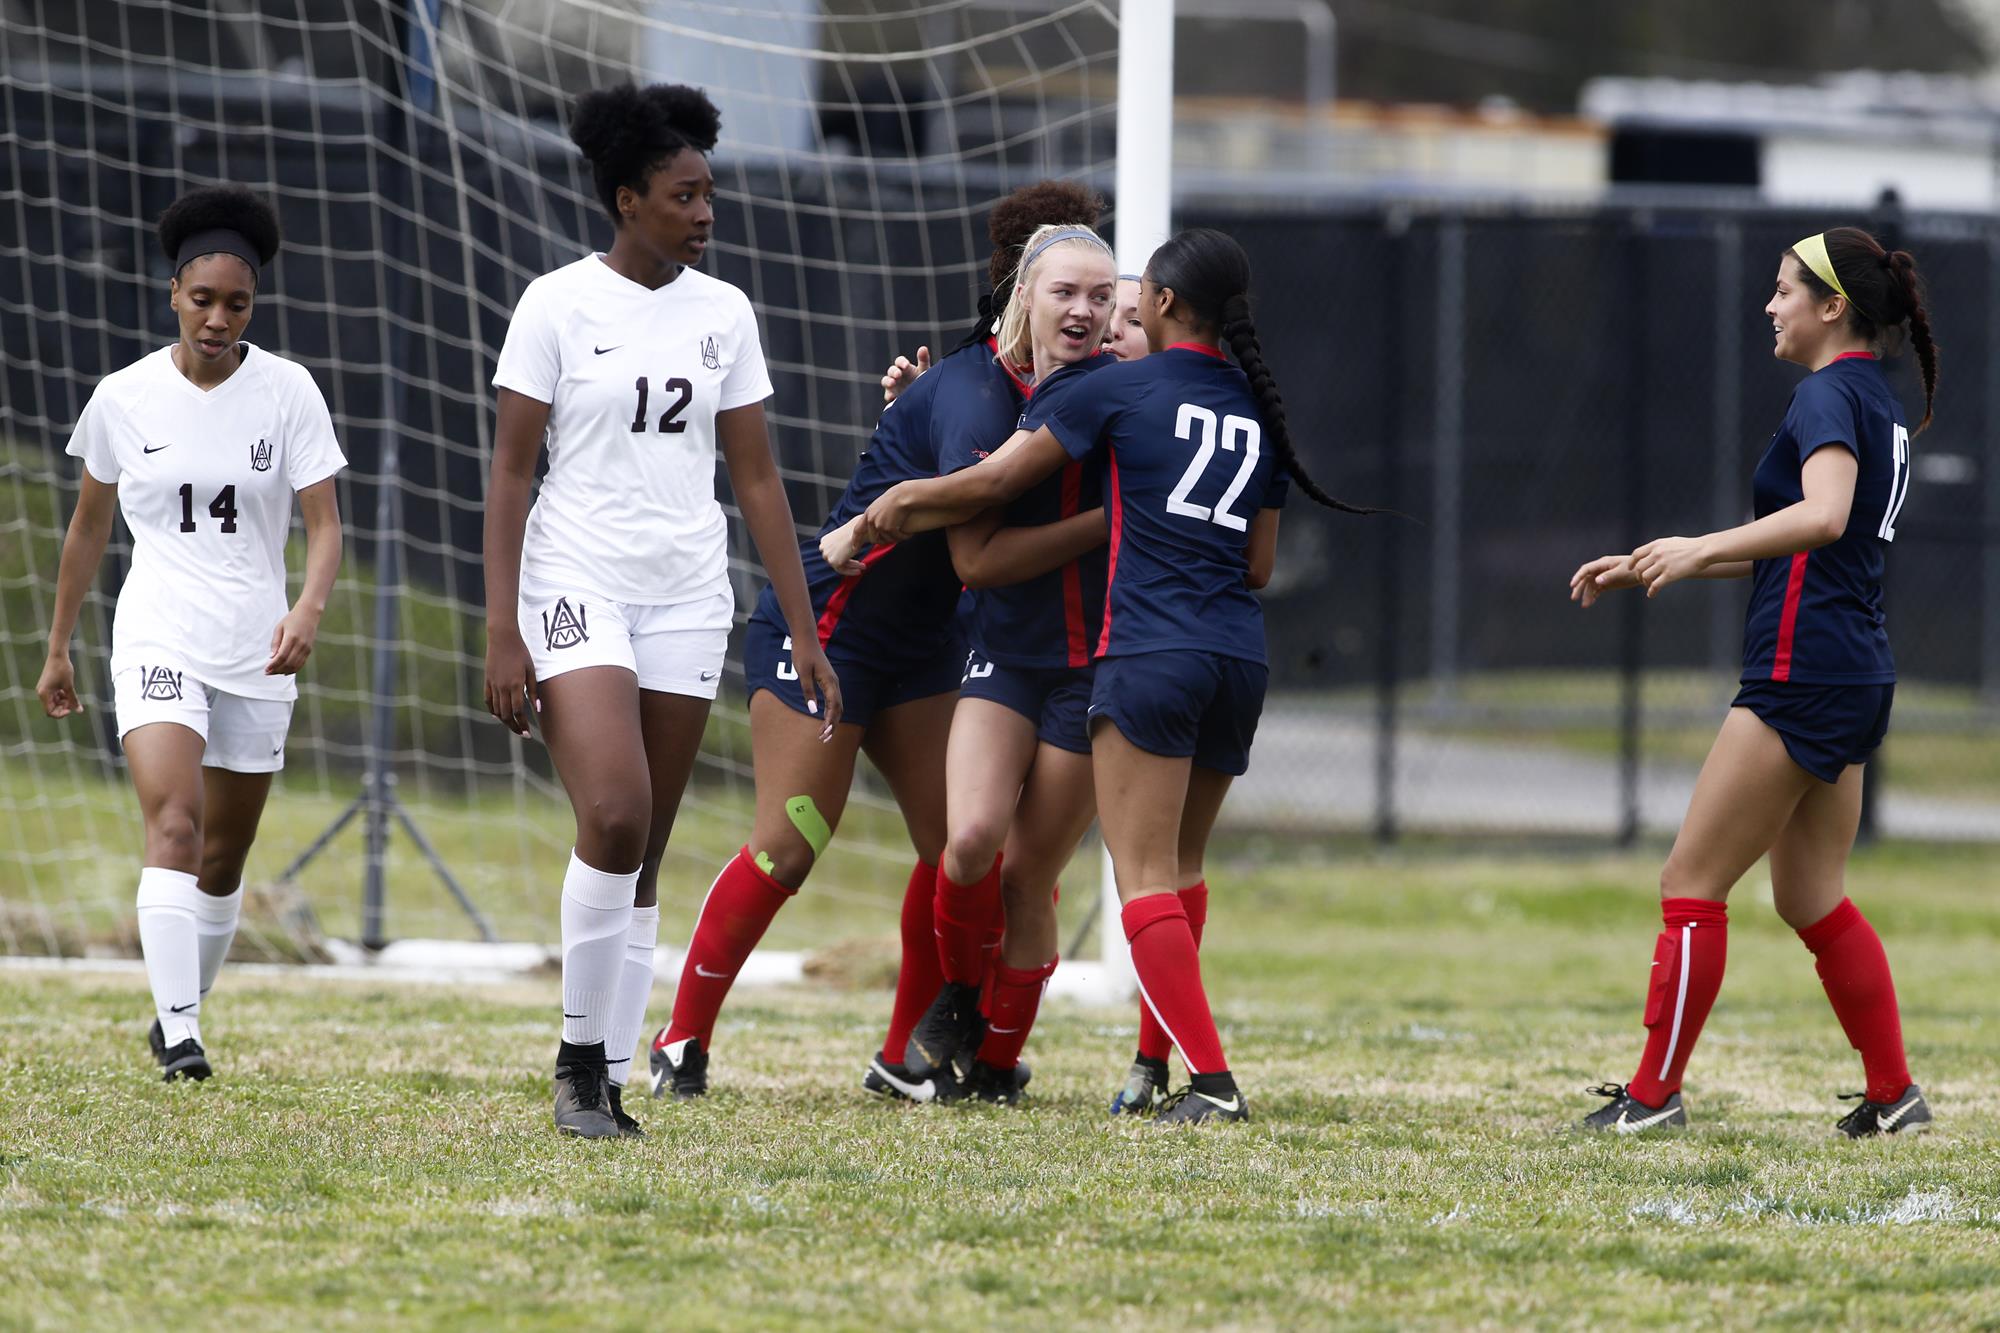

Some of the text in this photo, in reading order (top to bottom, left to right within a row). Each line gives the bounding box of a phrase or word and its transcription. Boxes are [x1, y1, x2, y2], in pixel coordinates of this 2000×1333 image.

[631, 377, 693, 433] 12
[1166, 403, 1261, 533] 22
[179, 483, 238, 534] 14
